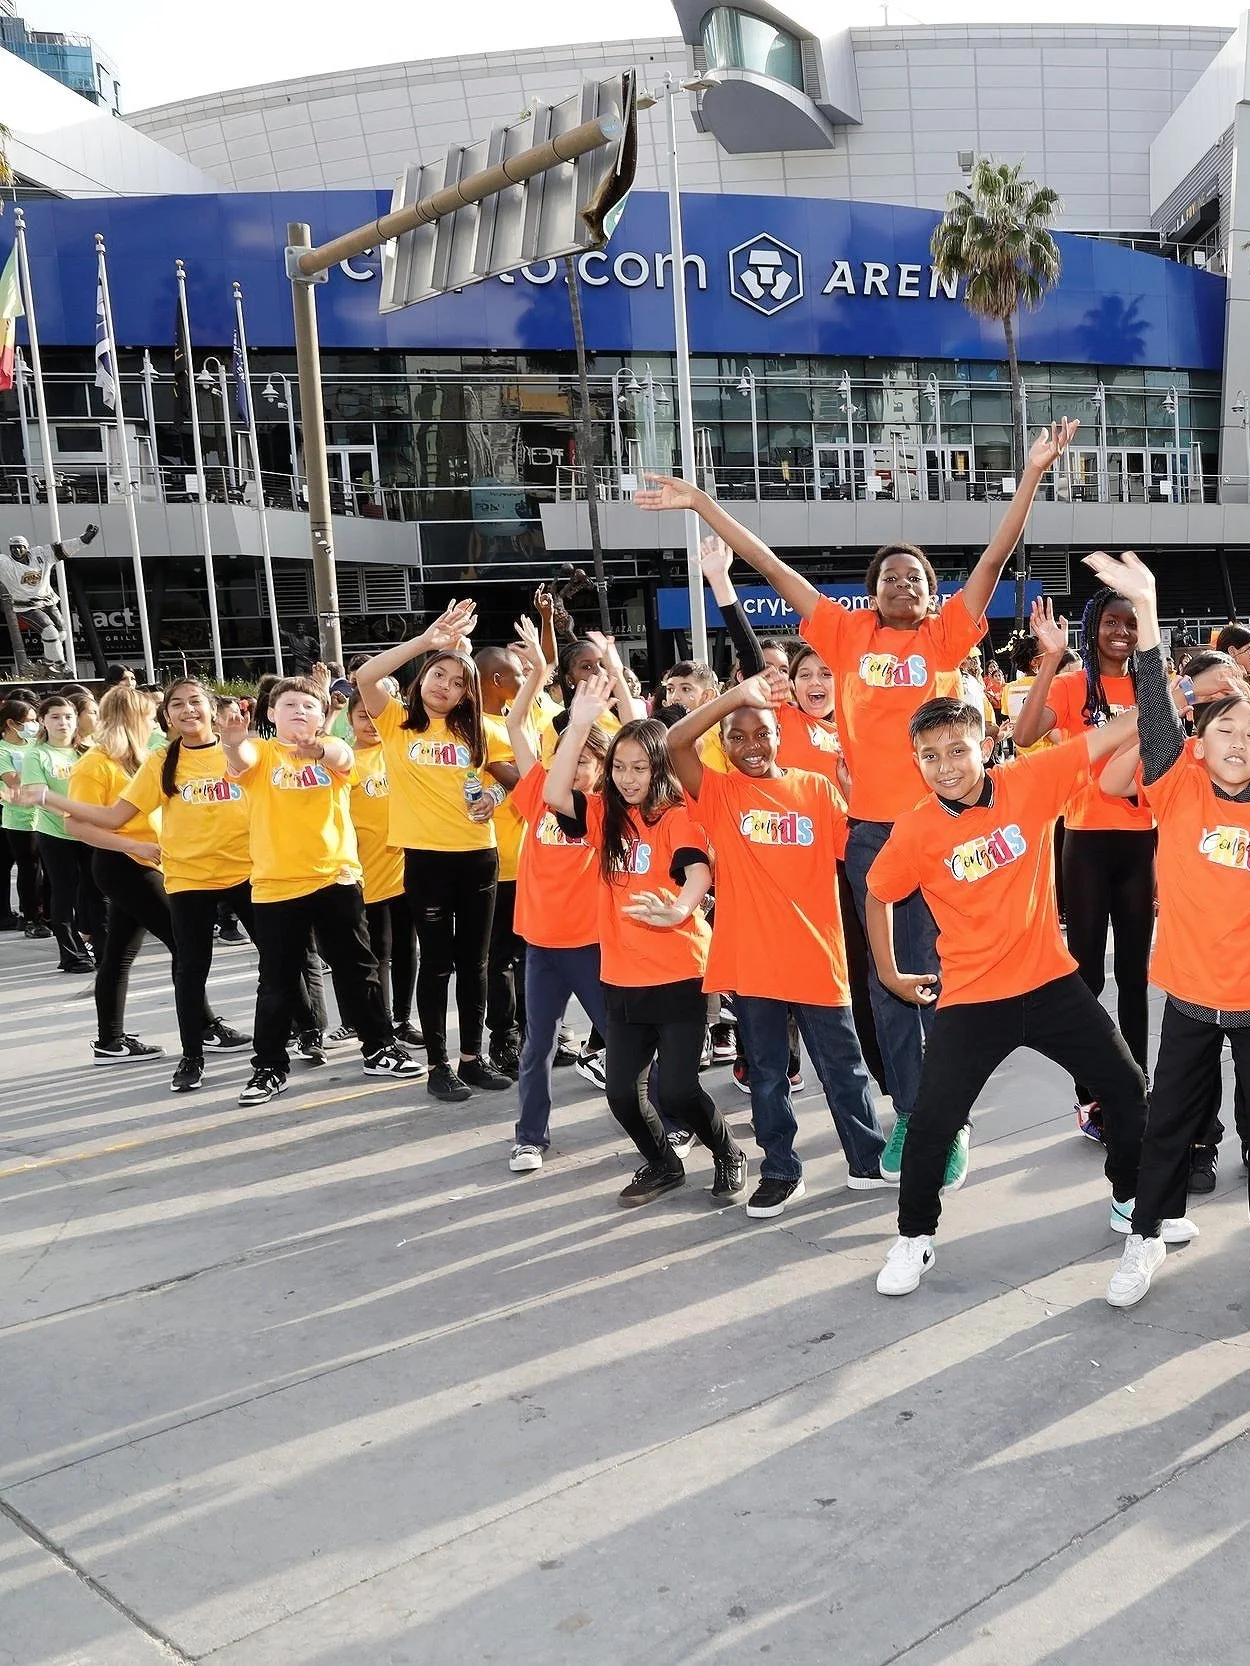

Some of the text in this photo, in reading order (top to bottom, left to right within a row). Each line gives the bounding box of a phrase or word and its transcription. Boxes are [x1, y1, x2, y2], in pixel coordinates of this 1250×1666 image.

[821, 258, 969, 299] AREN
[750, 809, 813, 846] Kids
[953, 824, 1027, 882] Kids
